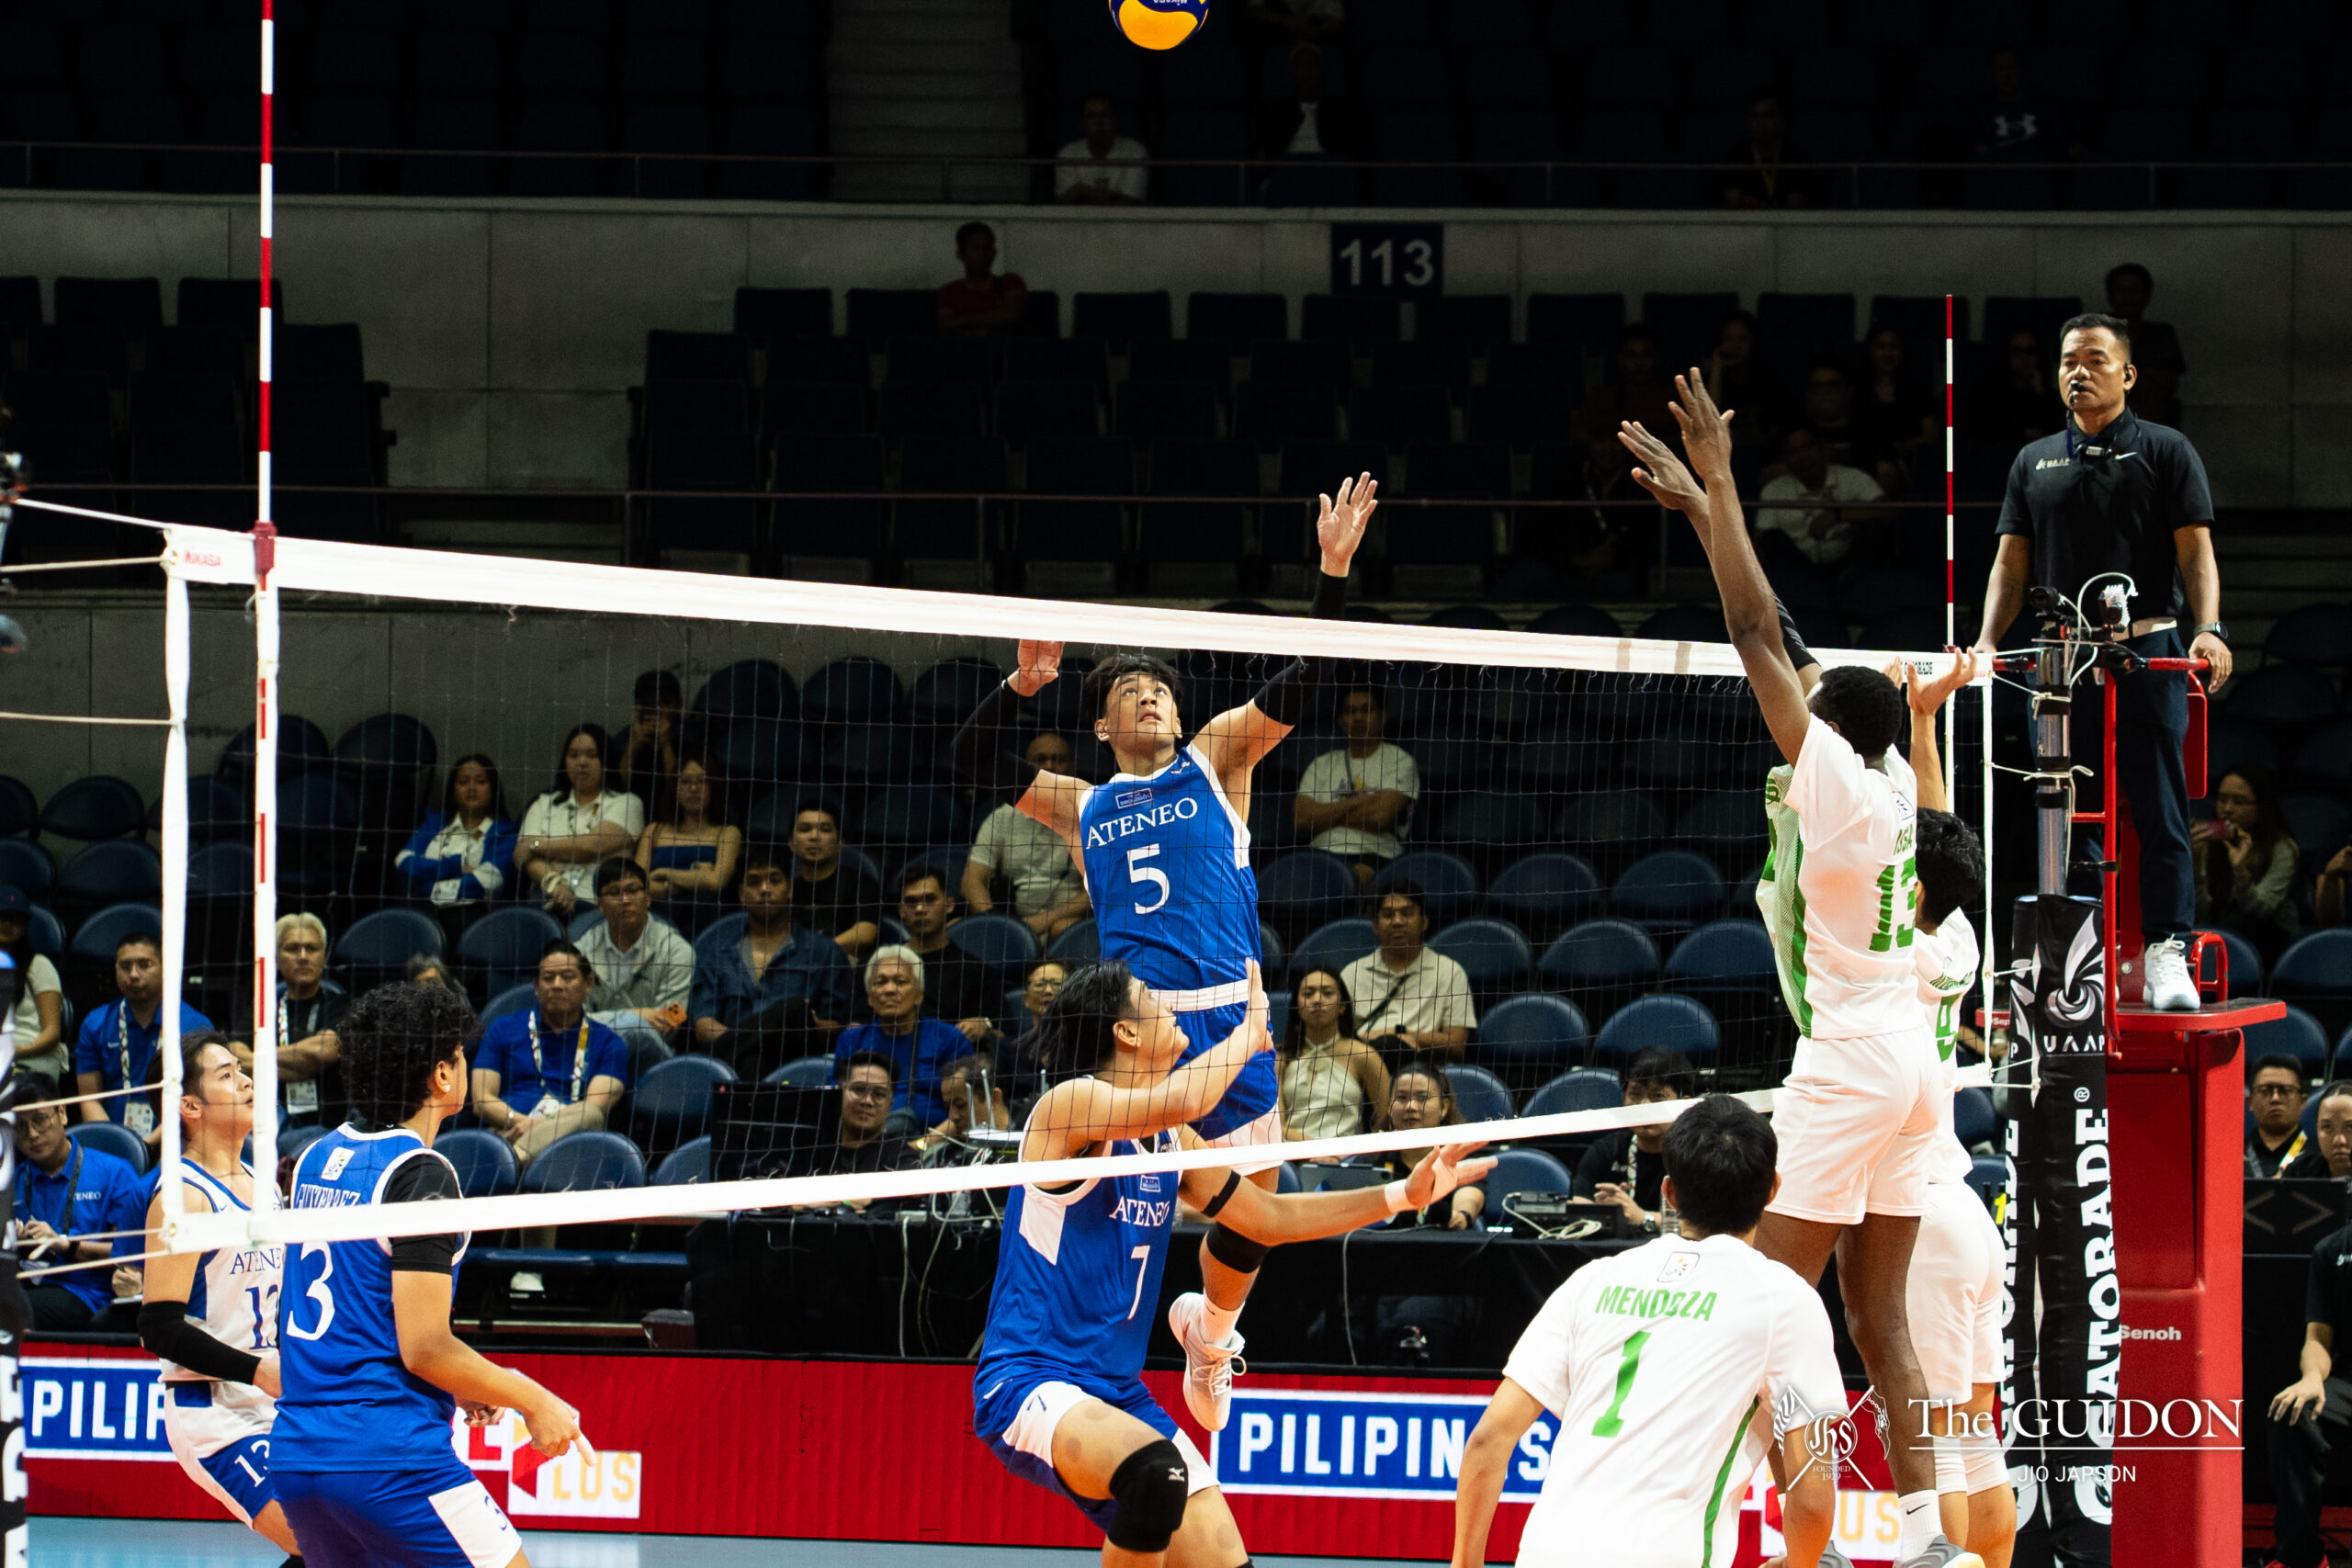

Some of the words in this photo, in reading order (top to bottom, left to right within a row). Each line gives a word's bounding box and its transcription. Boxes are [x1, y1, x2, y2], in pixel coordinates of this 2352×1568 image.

[1340, 239, 1434, 287] 113
[185, 551, 221, 567] MIKASA
[1086, 797, 1198, 850] ATENEO
[1126, 842, 1170, 915] 5
[1109, 1195, 1170, 1227] ATENEO
[286, 1242, 336, 1341] 3
[1122, 1245, 1150, 1320] 7
[1595, 1285, 1718, 1322] MENDOZA
[2120, 1325, 2182, 1341] Senoh
[1590, 1330, 1652, 1438] 1
[1239, 1413, 1552, 1482] PILIPINS
